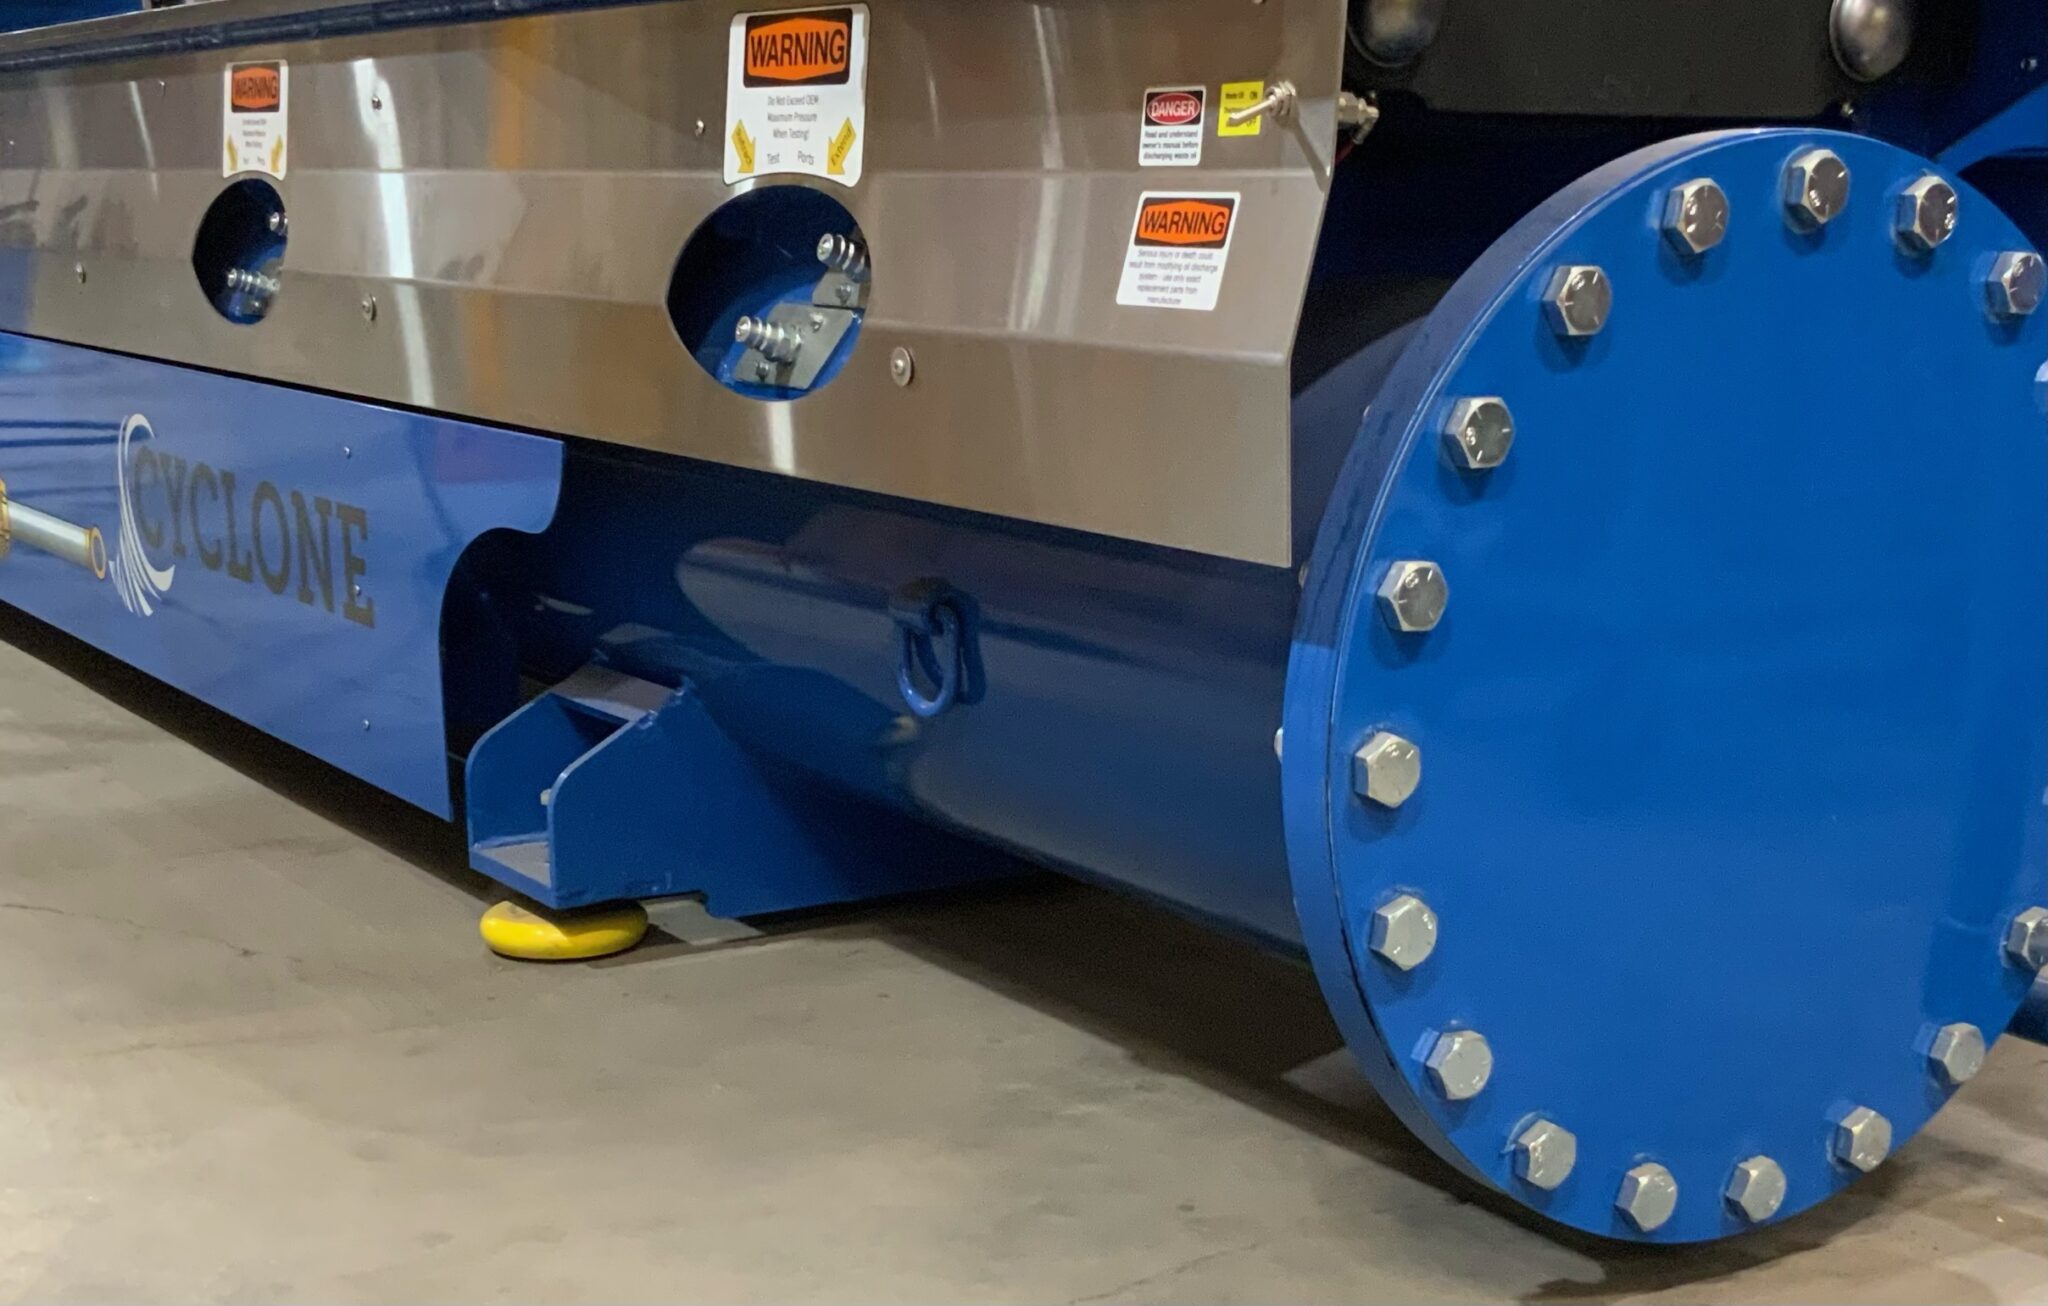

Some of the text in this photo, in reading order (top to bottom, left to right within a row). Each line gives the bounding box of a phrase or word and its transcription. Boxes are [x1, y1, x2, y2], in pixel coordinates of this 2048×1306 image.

[751, 29, 845, 67] WARNING
[233, 76, 278, 99] WARNING
[776, 96, 785, 106] Not
[1151, 100, 1197, 117] DANGER
[794, 111, 817, 122] Pressure
[1169, 130, 1199, 138] understand
[1182, 141, 1199, 149] before
[767, 152, 780, 165] Test
[1144, 211, 1226, 236] WARNING
[134, 445, 375, 629] CYCLONE
